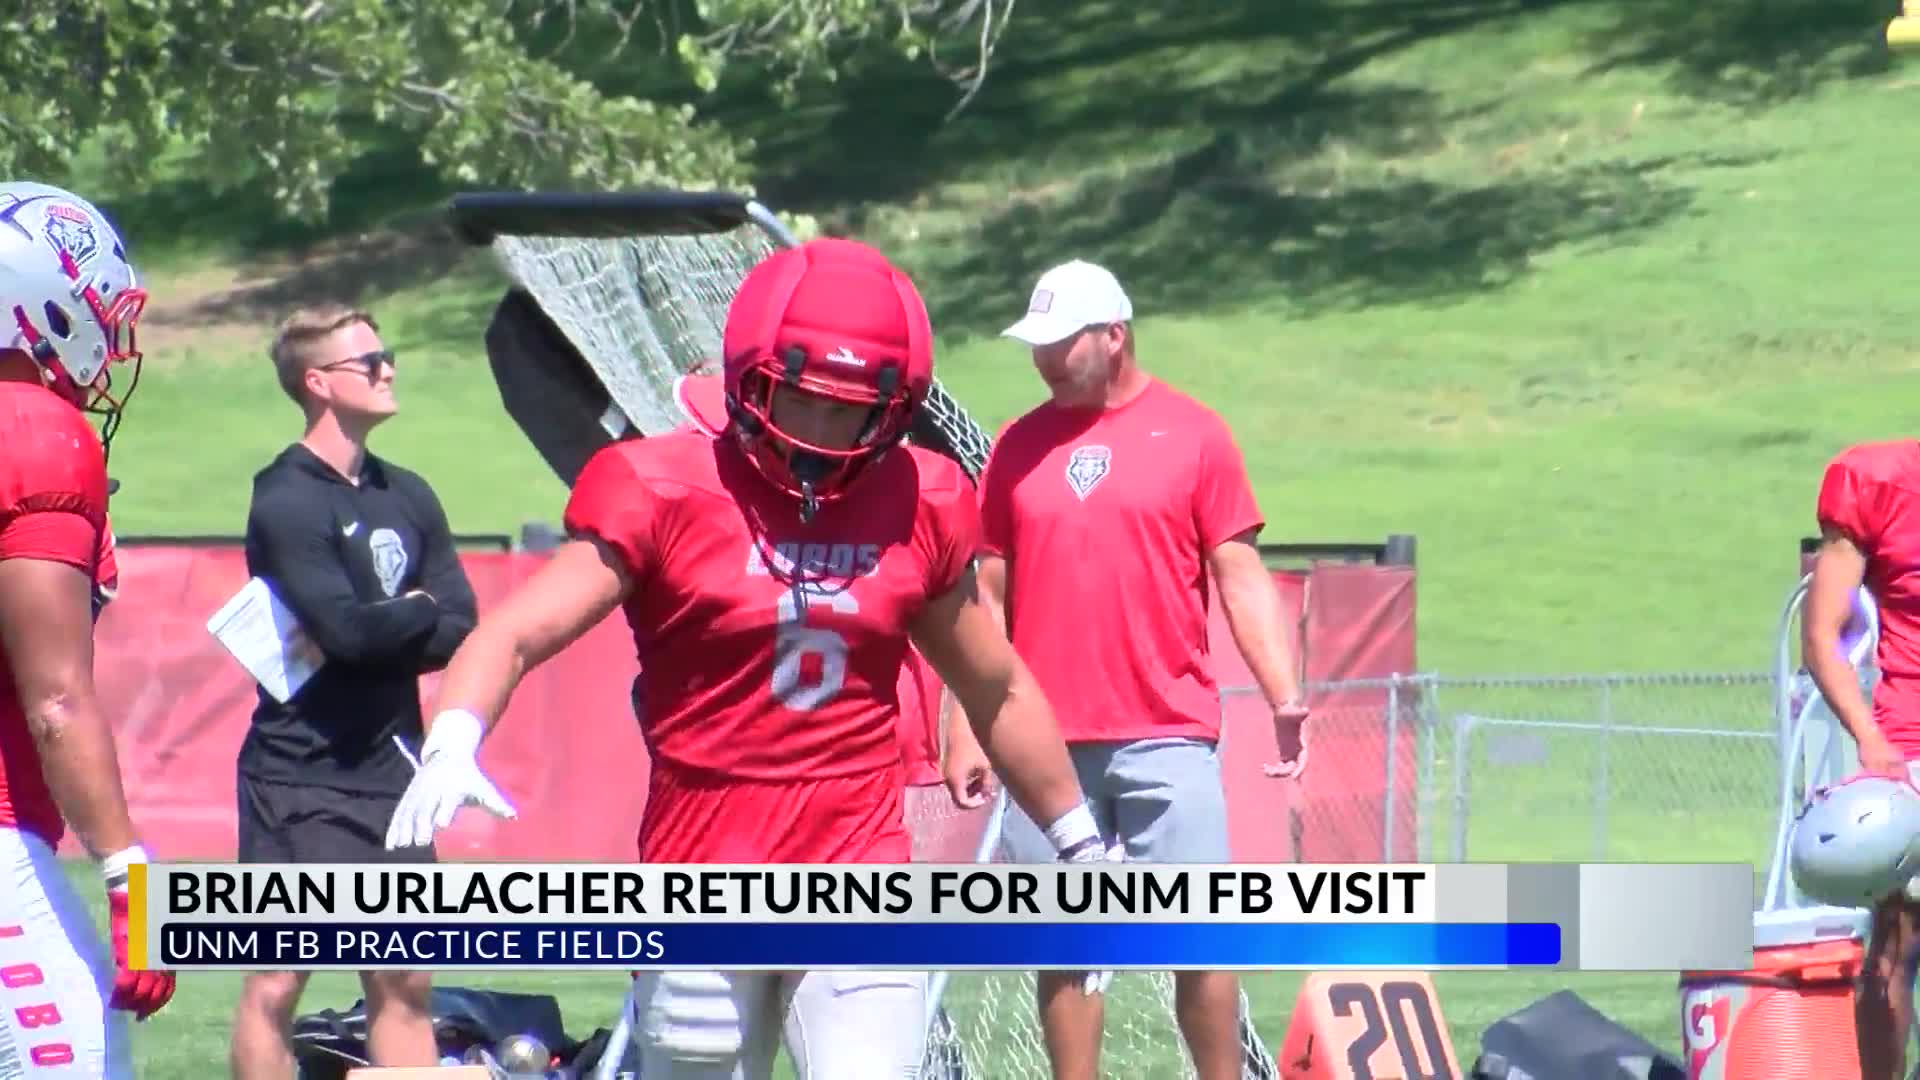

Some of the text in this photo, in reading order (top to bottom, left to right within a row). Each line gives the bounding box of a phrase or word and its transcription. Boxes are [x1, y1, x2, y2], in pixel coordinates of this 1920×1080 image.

[746, 543, 880, 577] LOBOS
[770, 588, 861, 711] 6
[1328, 981, 1454, 1080] 20
[1685, 989, 1717, 1049] G
